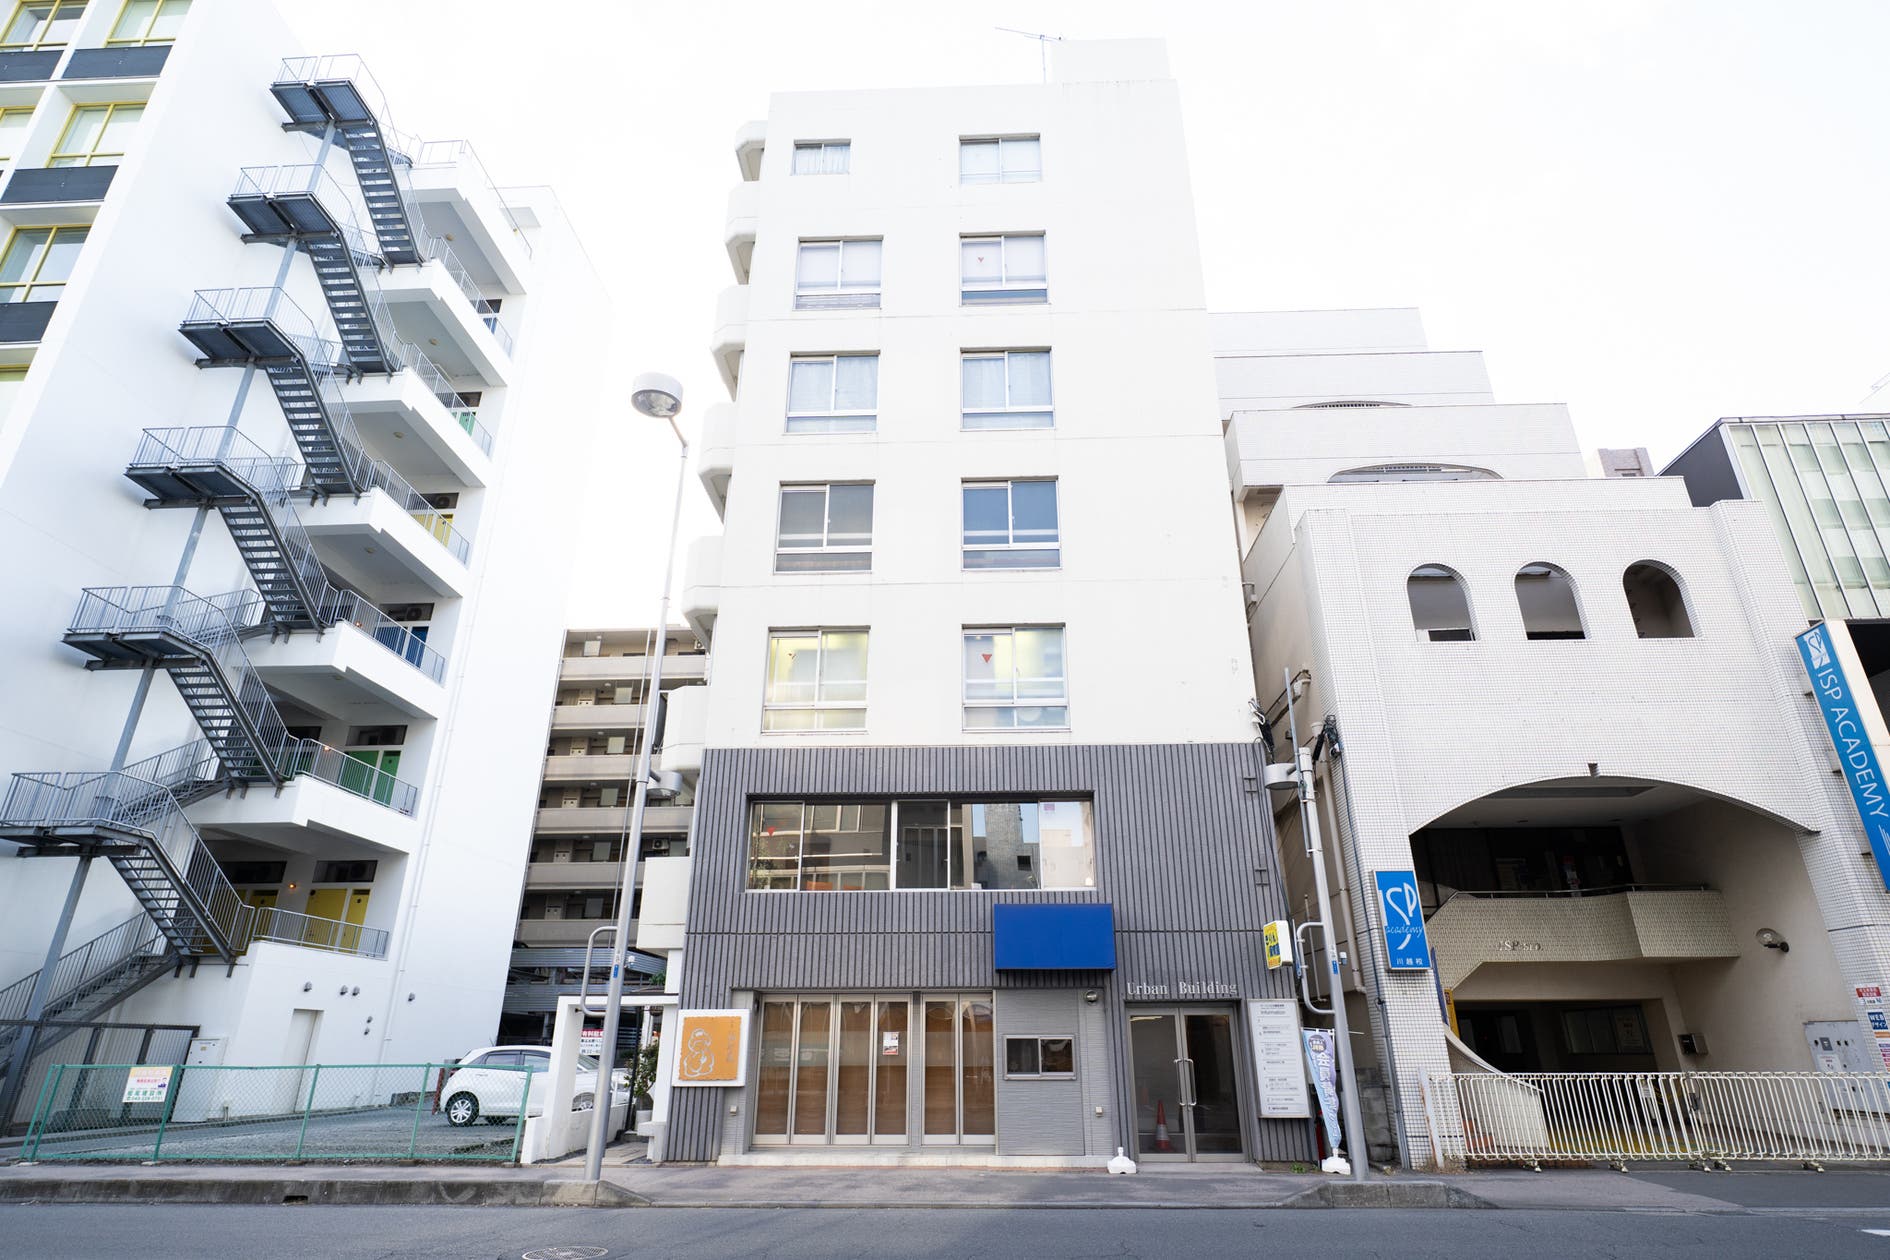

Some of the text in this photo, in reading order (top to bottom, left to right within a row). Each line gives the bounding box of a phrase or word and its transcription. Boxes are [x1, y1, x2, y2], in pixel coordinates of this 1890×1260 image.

[1817, 668, 1843, 700] ISP
[1830, 707, 1889, 817] ACADEMY
[1385, 923, 1423, 938] academy
[1396, 957, 1423, 966] 川越校
[1127, 981, 1238, 996] Urban Building
